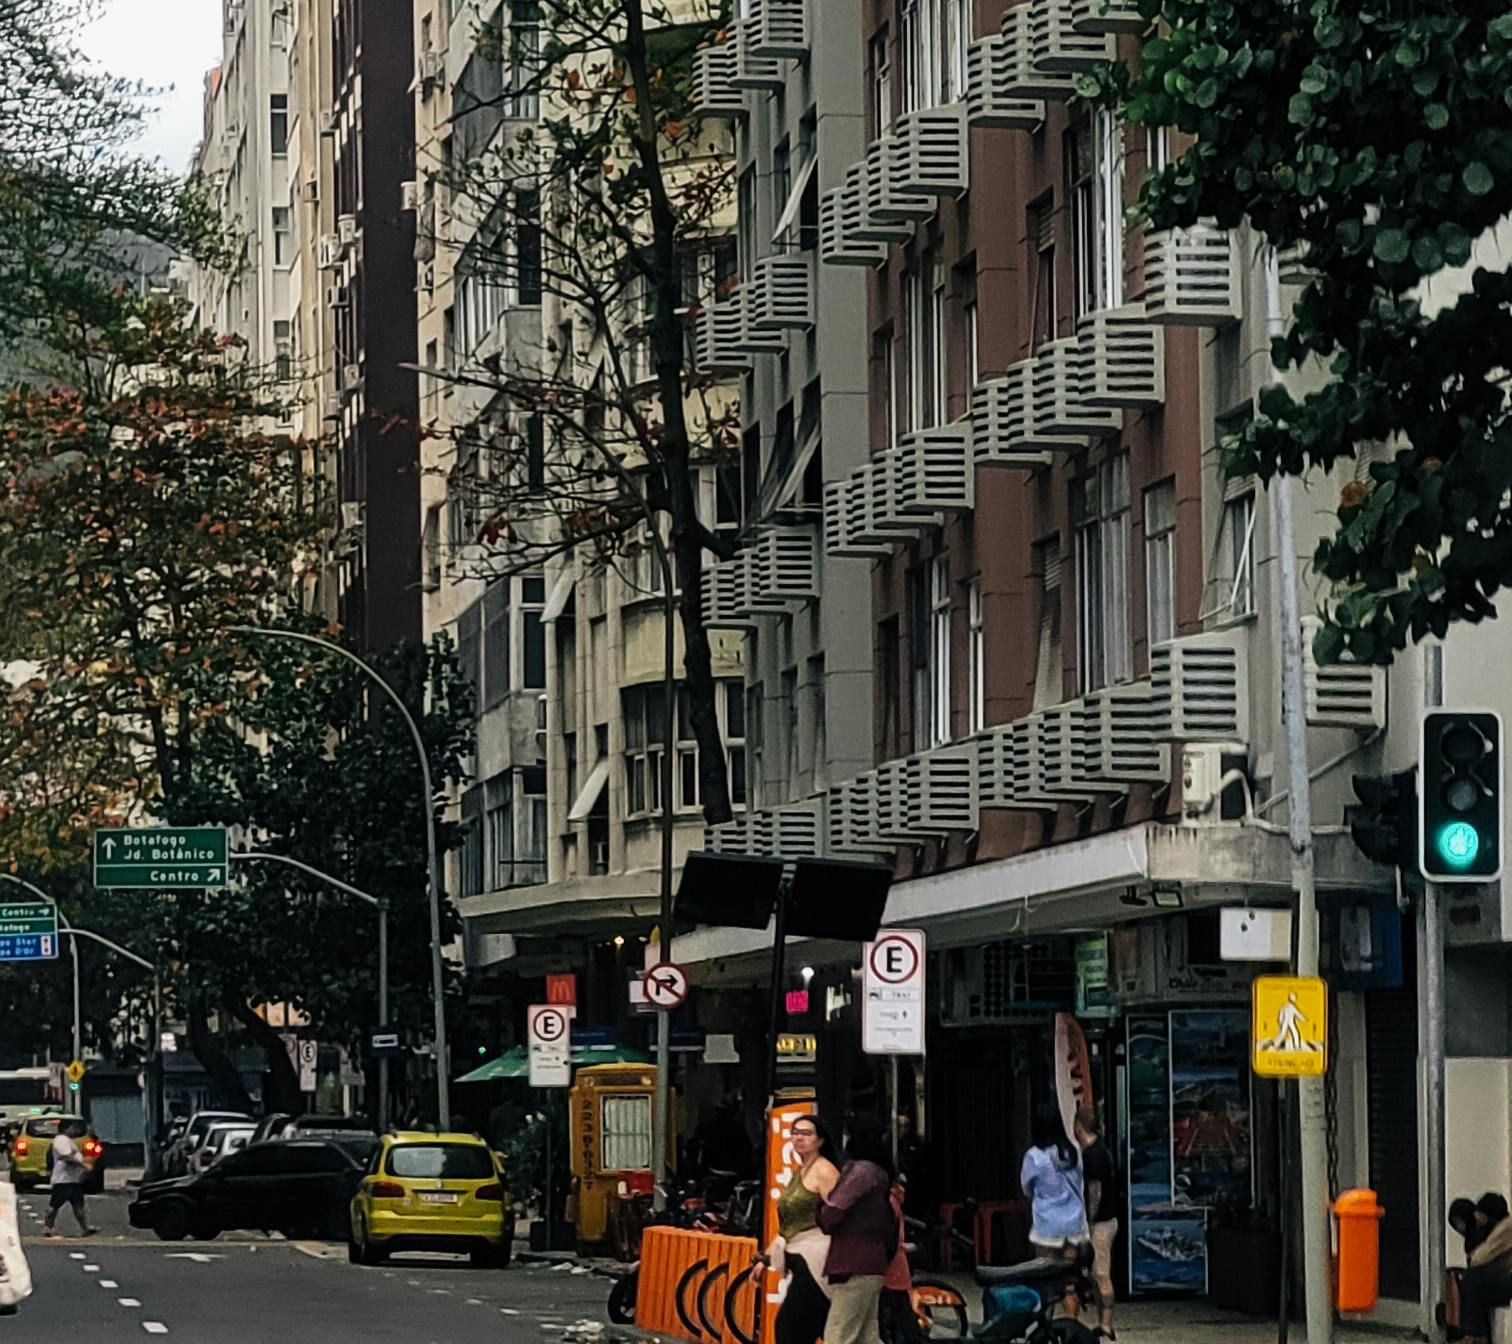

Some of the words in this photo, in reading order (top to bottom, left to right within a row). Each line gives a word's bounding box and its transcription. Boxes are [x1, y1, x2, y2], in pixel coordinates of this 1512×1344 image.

[123, 834, 186, 848] Botafogo
[124, 848, 145, 860] Jd.
[151, 847, 215, 860] Botânico
[150, 870, 199, 882] Centro
[1, 908, 35, 917] Centro
[886, 946, 903, 973] E
[543, 1016, 555, 1034] E
